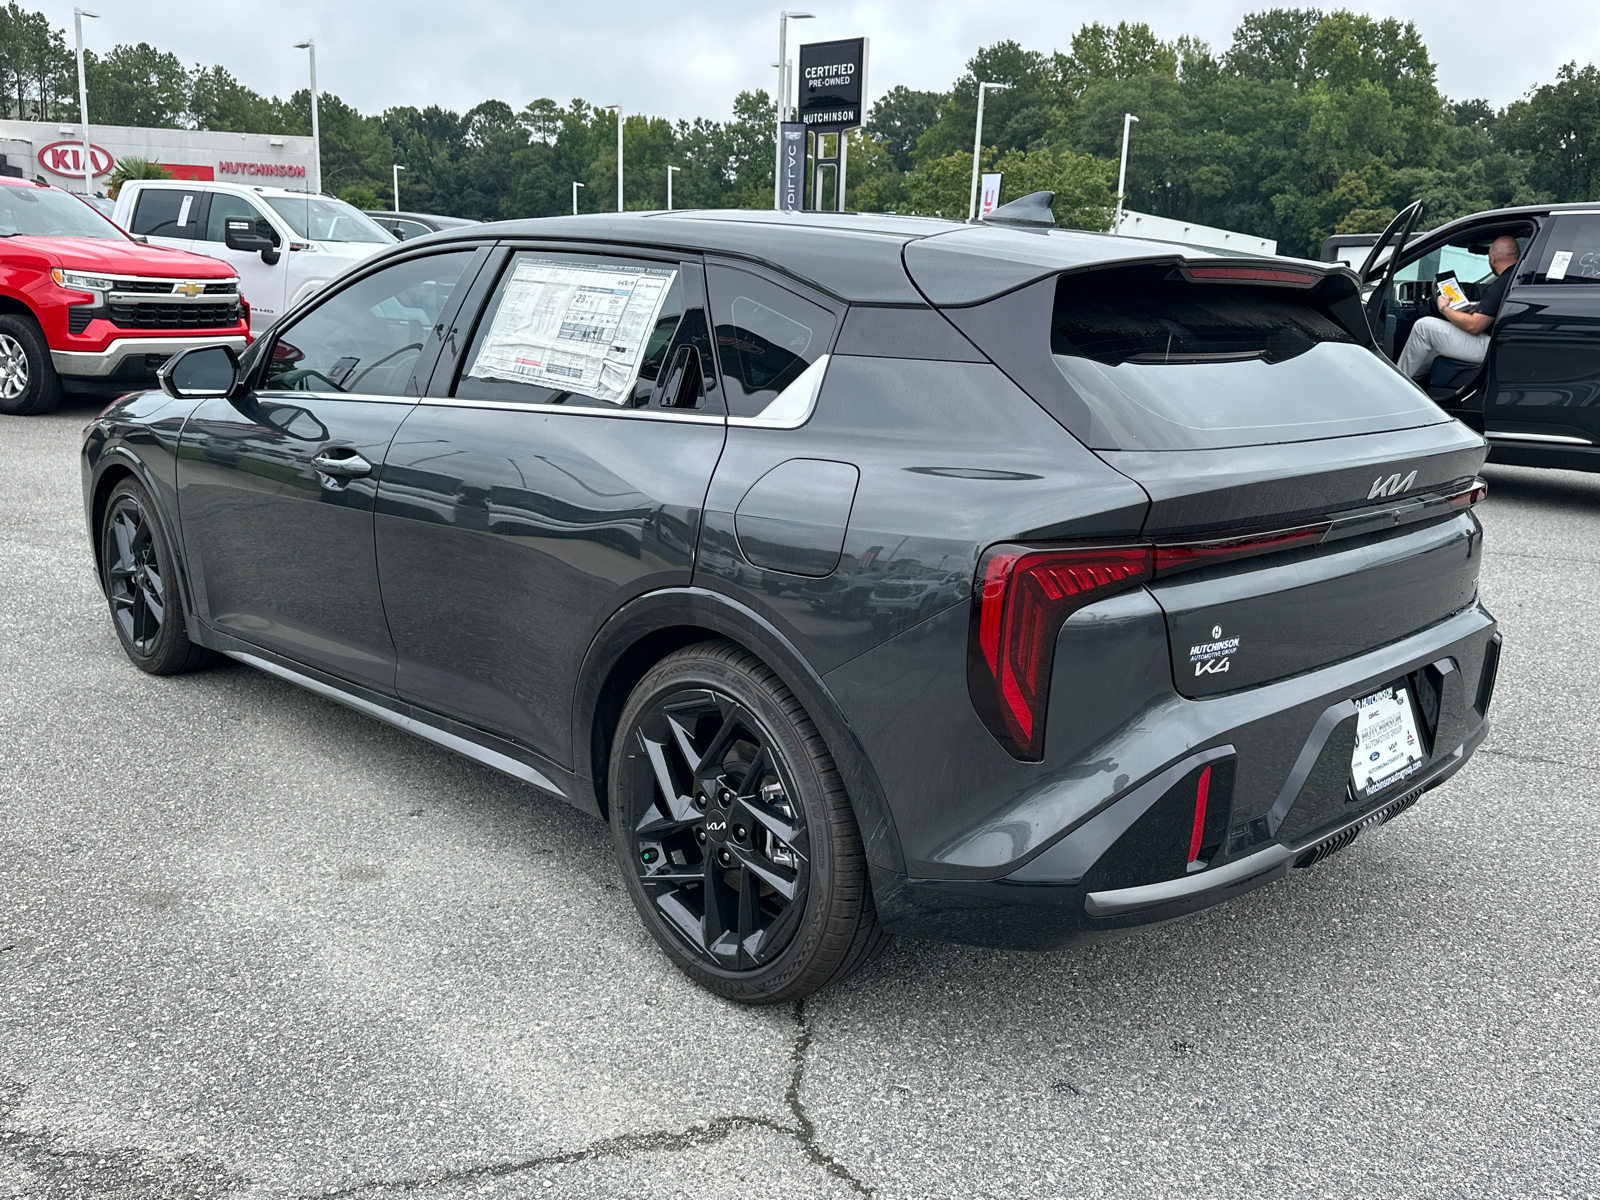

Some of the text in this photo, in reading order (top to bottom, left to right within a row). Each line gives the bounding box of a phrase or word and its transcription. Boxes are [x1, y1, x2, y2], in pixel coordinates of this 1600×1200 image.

[804, 63, 855, 79] CERTIFIED
[808, 76, 850, 88] PRE-OWNED
[803, 110, 854, 125] HUTCHINSON
[51, 148, 102, 172] KIA
[219, 161, 306, 178] HUTCHINSON
[787, 145, 797, 210] DILLAC
[1367, 470, 1418, 500] KIA
[1189, 638, 1240, 655] HUTCHINSON
[1190, 647, 1237, 662] AUTOMOTIVE GROUP
[1194, 656, 1230, 677] K4
[1361, 711, 1403, 742] HUTCHINSON
[706, 821, 727, 830] KIA
